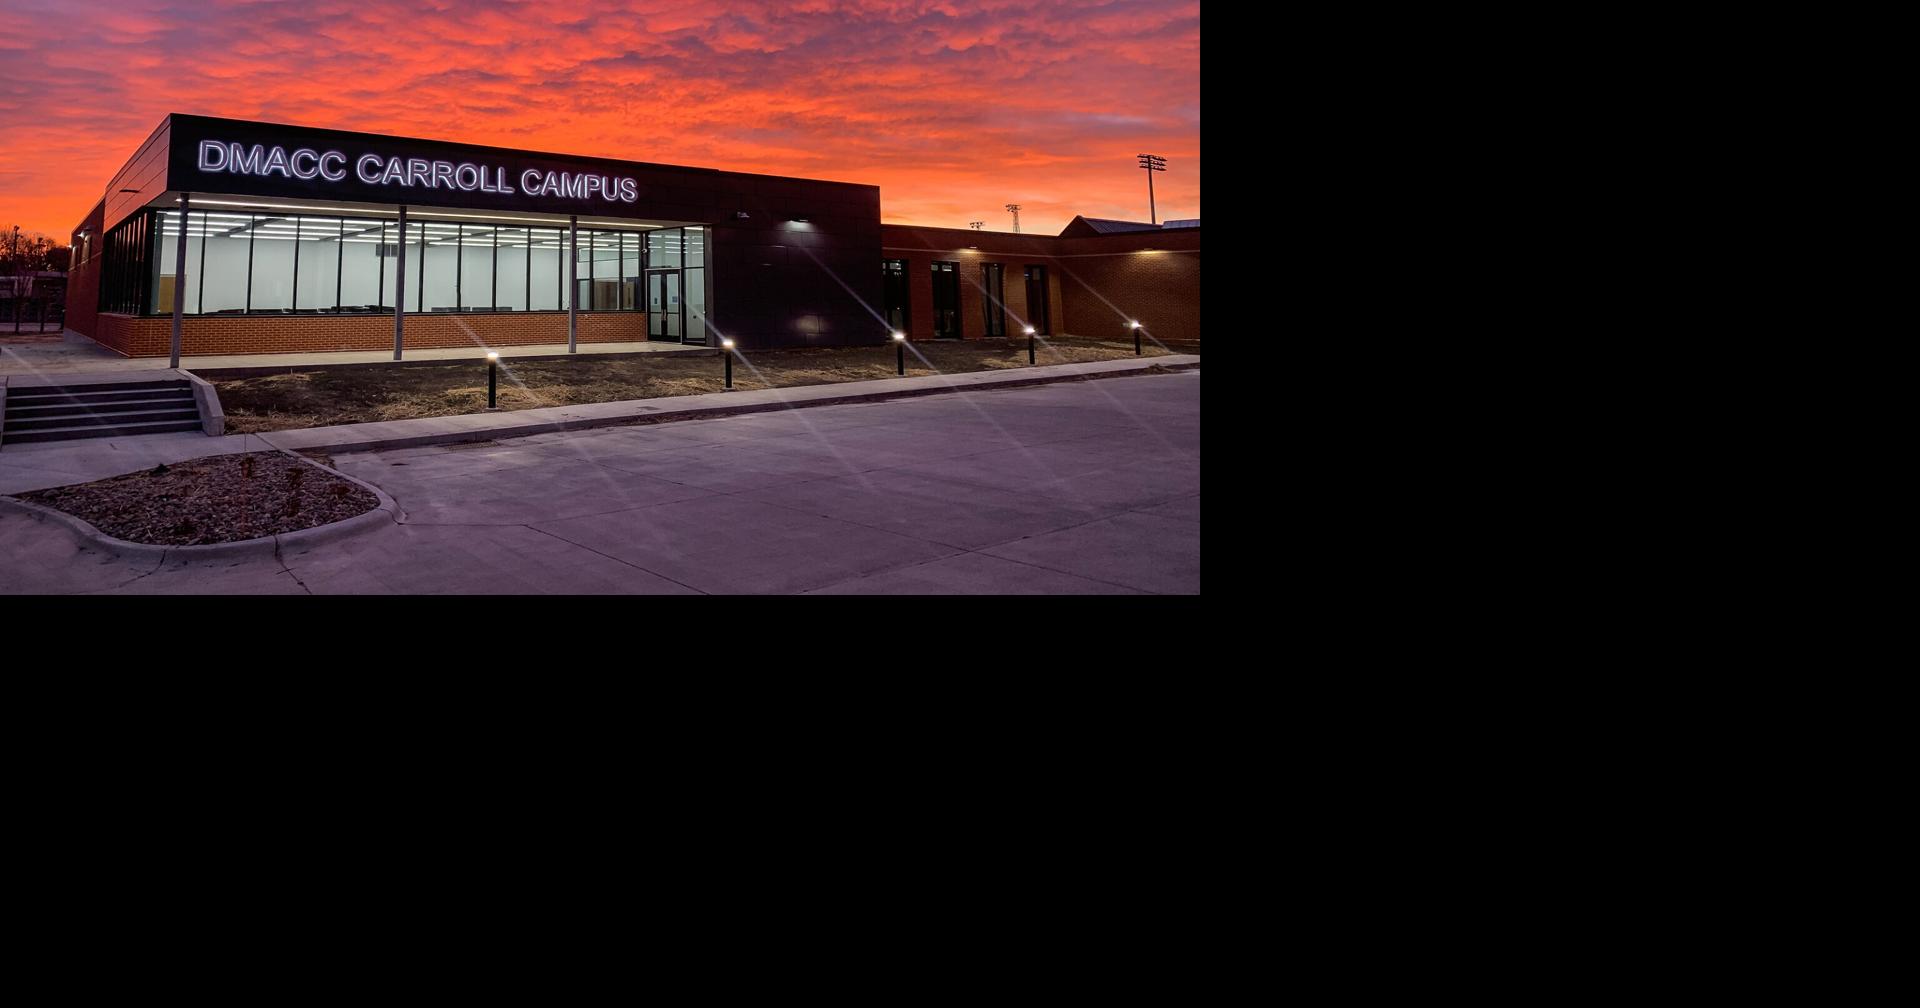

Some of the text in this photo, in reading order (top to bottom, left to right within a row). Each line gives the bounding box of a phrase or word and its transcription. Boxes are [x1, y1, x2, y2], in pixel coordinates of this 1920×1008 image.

[198, 140, 639, 203] DMACC CARROLL CAMPUS
